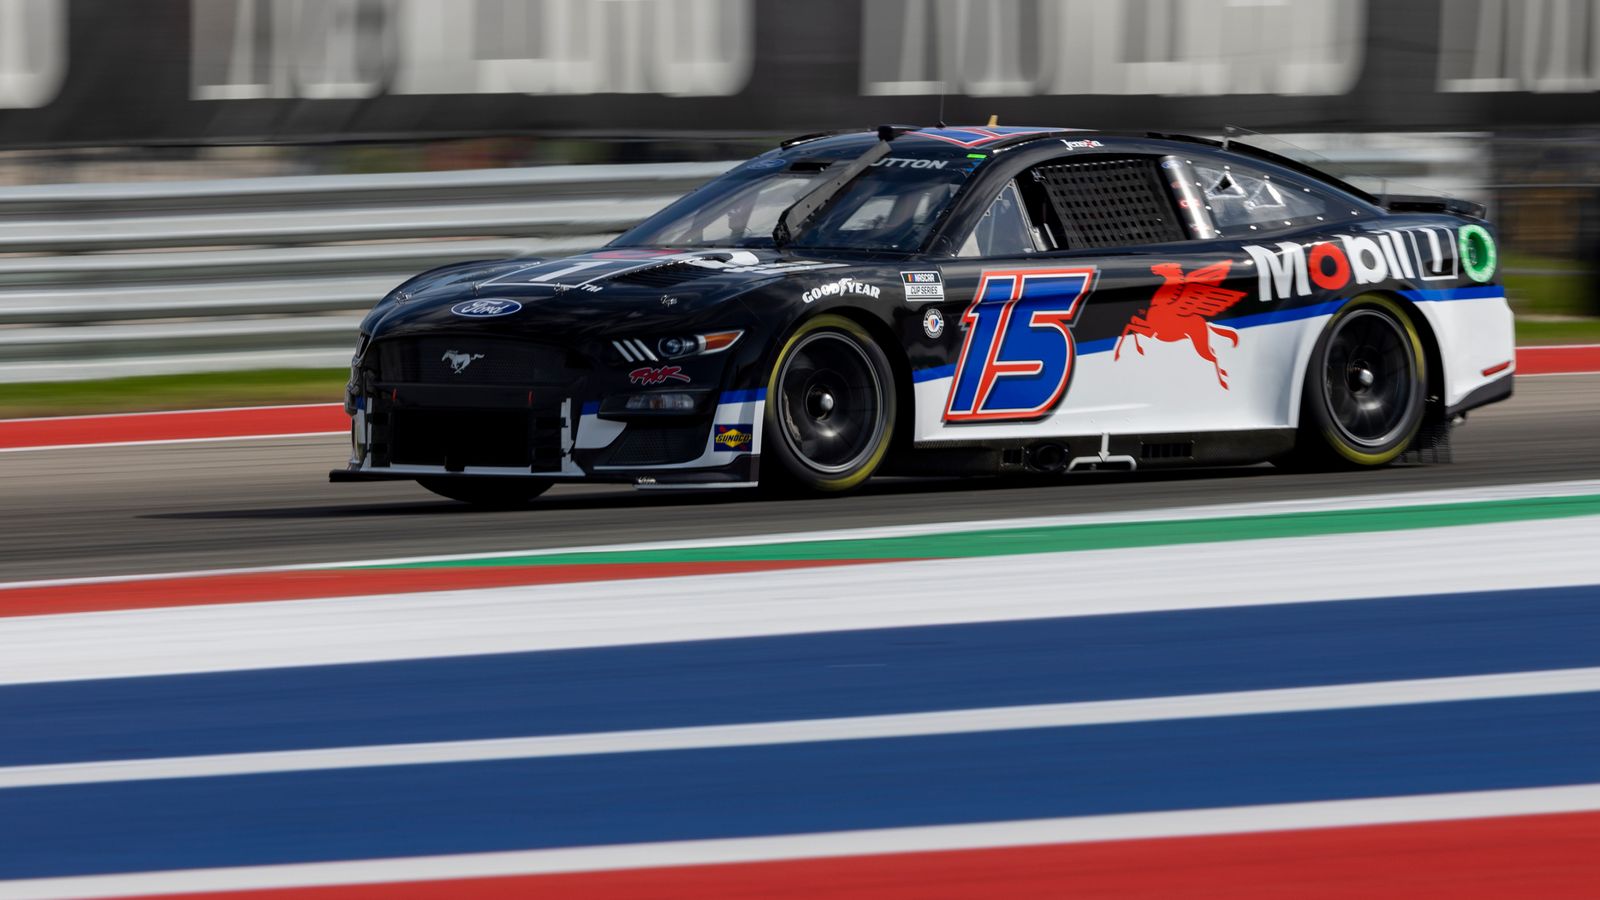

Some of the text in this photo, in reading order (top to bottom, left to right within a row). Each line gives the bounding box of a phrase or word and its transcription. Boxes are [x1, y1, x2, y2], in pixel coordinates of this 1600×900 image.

[869, 157, 949, 169] UTTON
[1241, 229, 1415, 302] Mobil
[914, 273, 935, 282] NASCAR
[802, 278, 880, 303] GOODYEAR
[911, 286, 938, 294] CUP SERIES
[461, 300, 511, 314] Ford
[943, 267, 1096, 421] 15
[716, 434, 751, 443] SUNOCO
